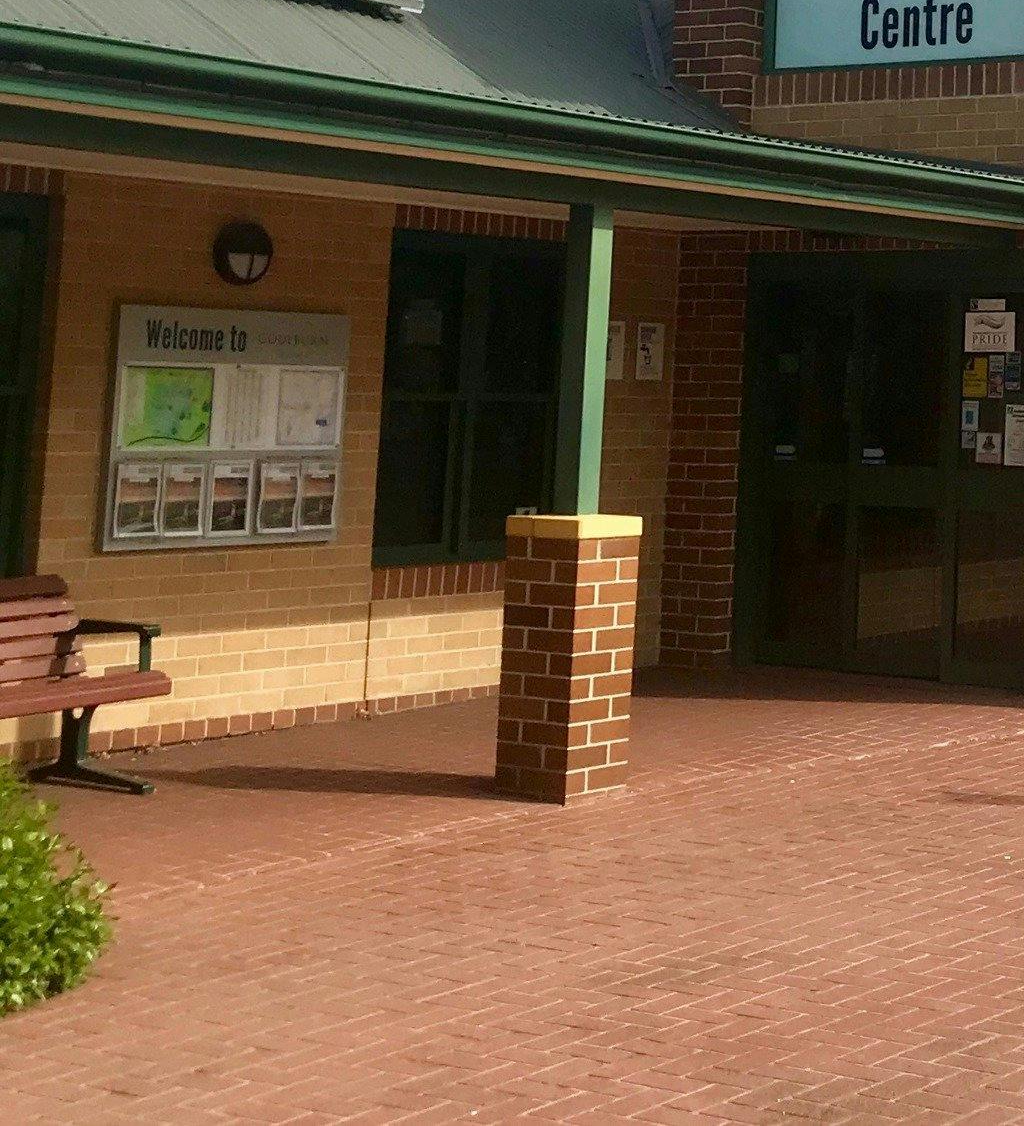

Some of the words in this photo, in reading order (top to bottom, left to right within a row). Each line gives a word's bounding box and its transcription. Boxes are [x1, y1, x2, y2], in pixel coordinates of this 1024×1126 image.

[146, 319, 224, 352] Welcome
[230, 325, 248, 353] to
[972, 333, 1008, 345] PRIDE
